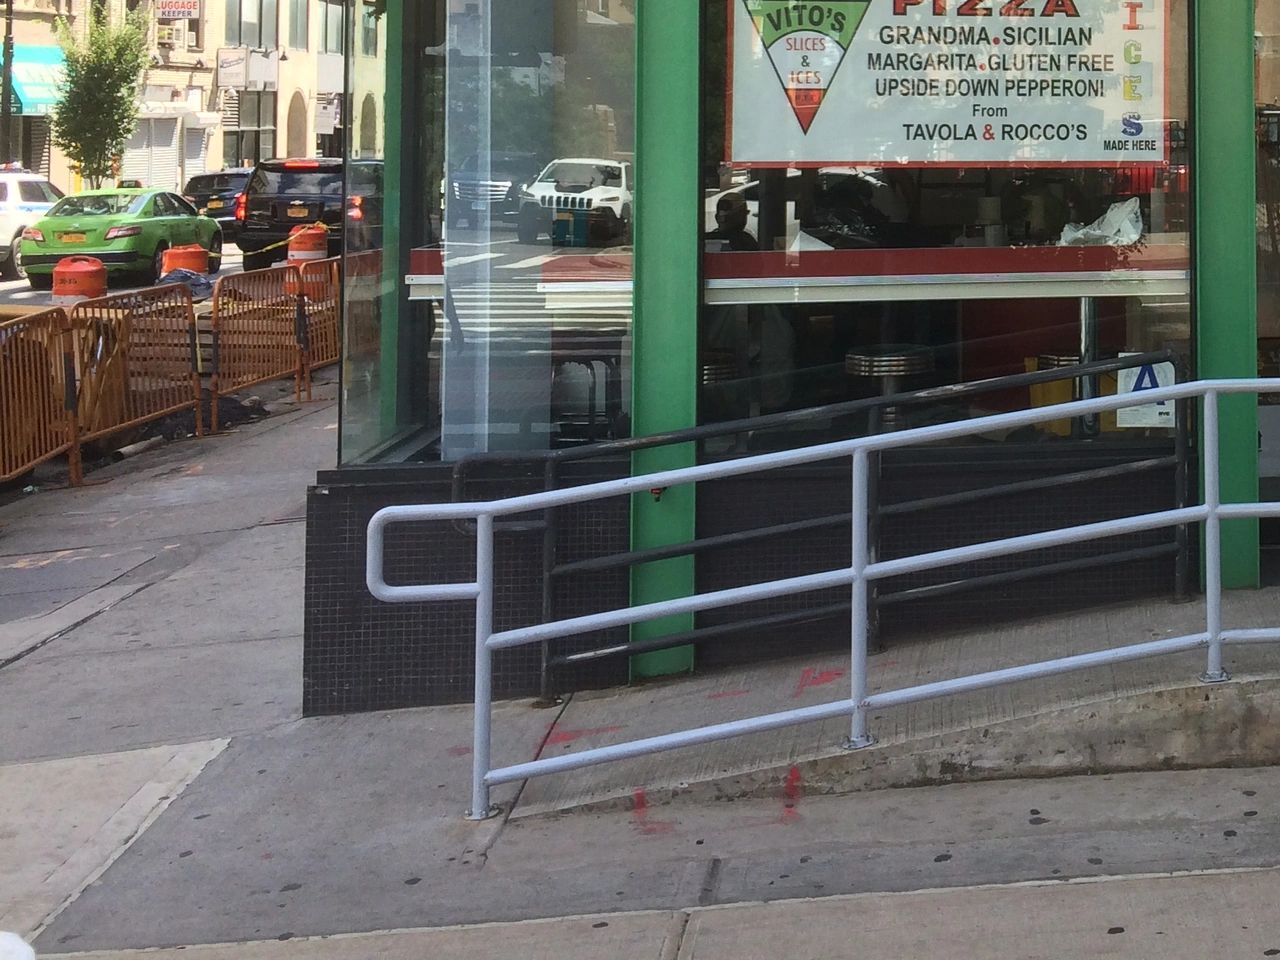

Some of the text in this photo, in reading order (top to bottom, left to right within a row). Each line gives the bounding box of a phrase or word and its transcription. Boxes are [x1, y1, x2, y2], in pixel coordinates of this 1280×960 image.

[157, 1, 198, 10] LUGGAGE
[766, 4, 847, 34] VITO'S
[879, 25, 1093, 47] GRANDMA SICILIAN
[785, 37, 827, 52] SLICES
[801, 54, 811, 68] &
[867, 53, 1114, 73] MARGARITA GLUTEN FREE
[790, 70, 821, 85] ICES
[875, 78, 1105, 98] UPSIDE DOWN PEPPERONI
[972, 103, 1008, 118] From
[902, 123, 1088, 142] TAVOLA & ROCCO'S
[1103, 140, 1157, 152] MADE HERE
